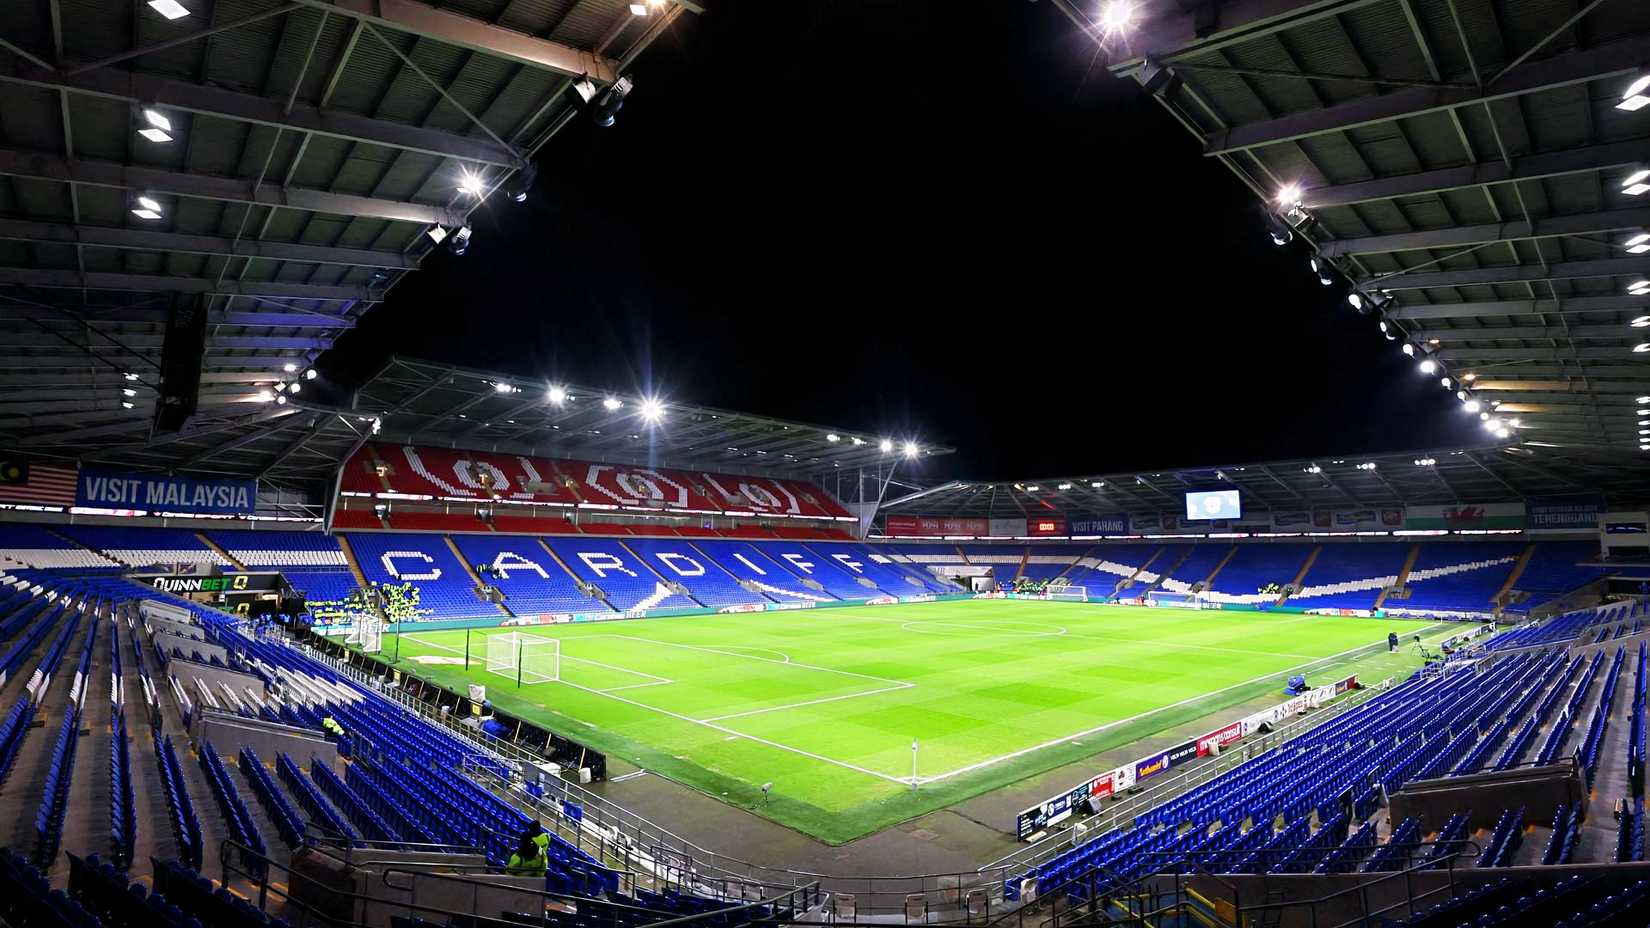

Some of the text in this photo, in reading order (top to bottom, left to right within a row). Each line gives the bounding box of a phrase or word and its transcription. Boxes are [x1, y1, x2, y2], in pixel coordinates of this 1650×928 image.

[85, 476, 249, 508] VISIT MALAYSIA
[1072, 520, 1123, 532] VISIT PAHANG
[381, 551, 863, 581] CARDIFF
[153, 577, 231, 592] QUINNBET
